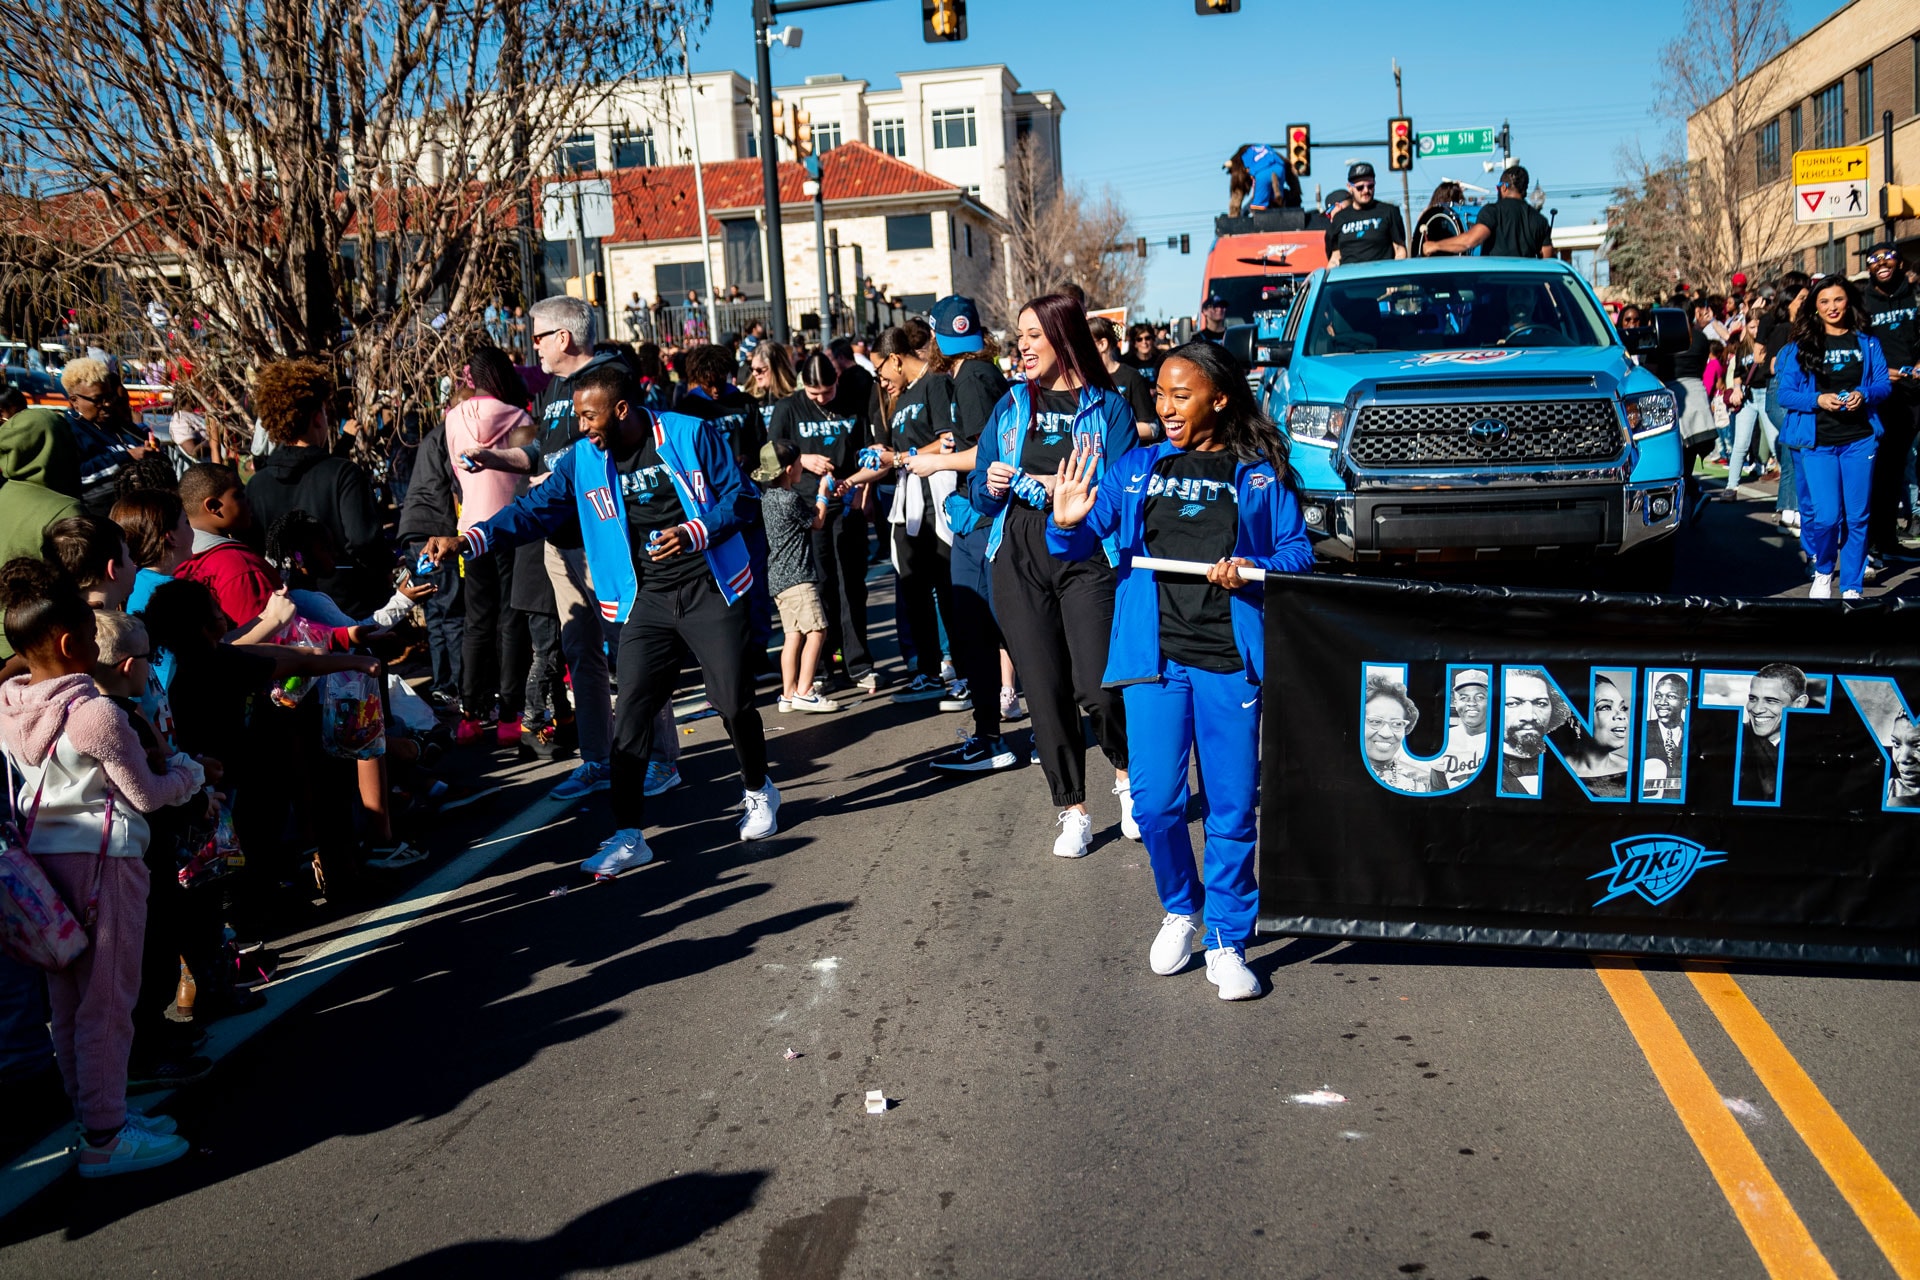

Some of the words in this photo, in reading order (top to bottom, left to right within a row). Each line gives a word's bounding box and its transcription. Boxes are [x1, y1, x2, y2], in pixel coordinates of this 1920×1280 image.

[1436, 134, 1449, 145] NW
[1458, 131, 1475, 144] 5TH
[1482, 130, 1492, 143] ST
[1801, 155, 1842, 166] TURNING
[1801, 168, 1844, 179] VEHICLES
[1829, 195, 1840, 205] TO
[1341, 217, 1382, 235] UNITY
[1871, 308, 1918, 327] UNITY
[798, 418, 856, 438] UNITY
[1359, 661, 1920, 813] UNITY
[1613, 849, 1683, 888] OKC
